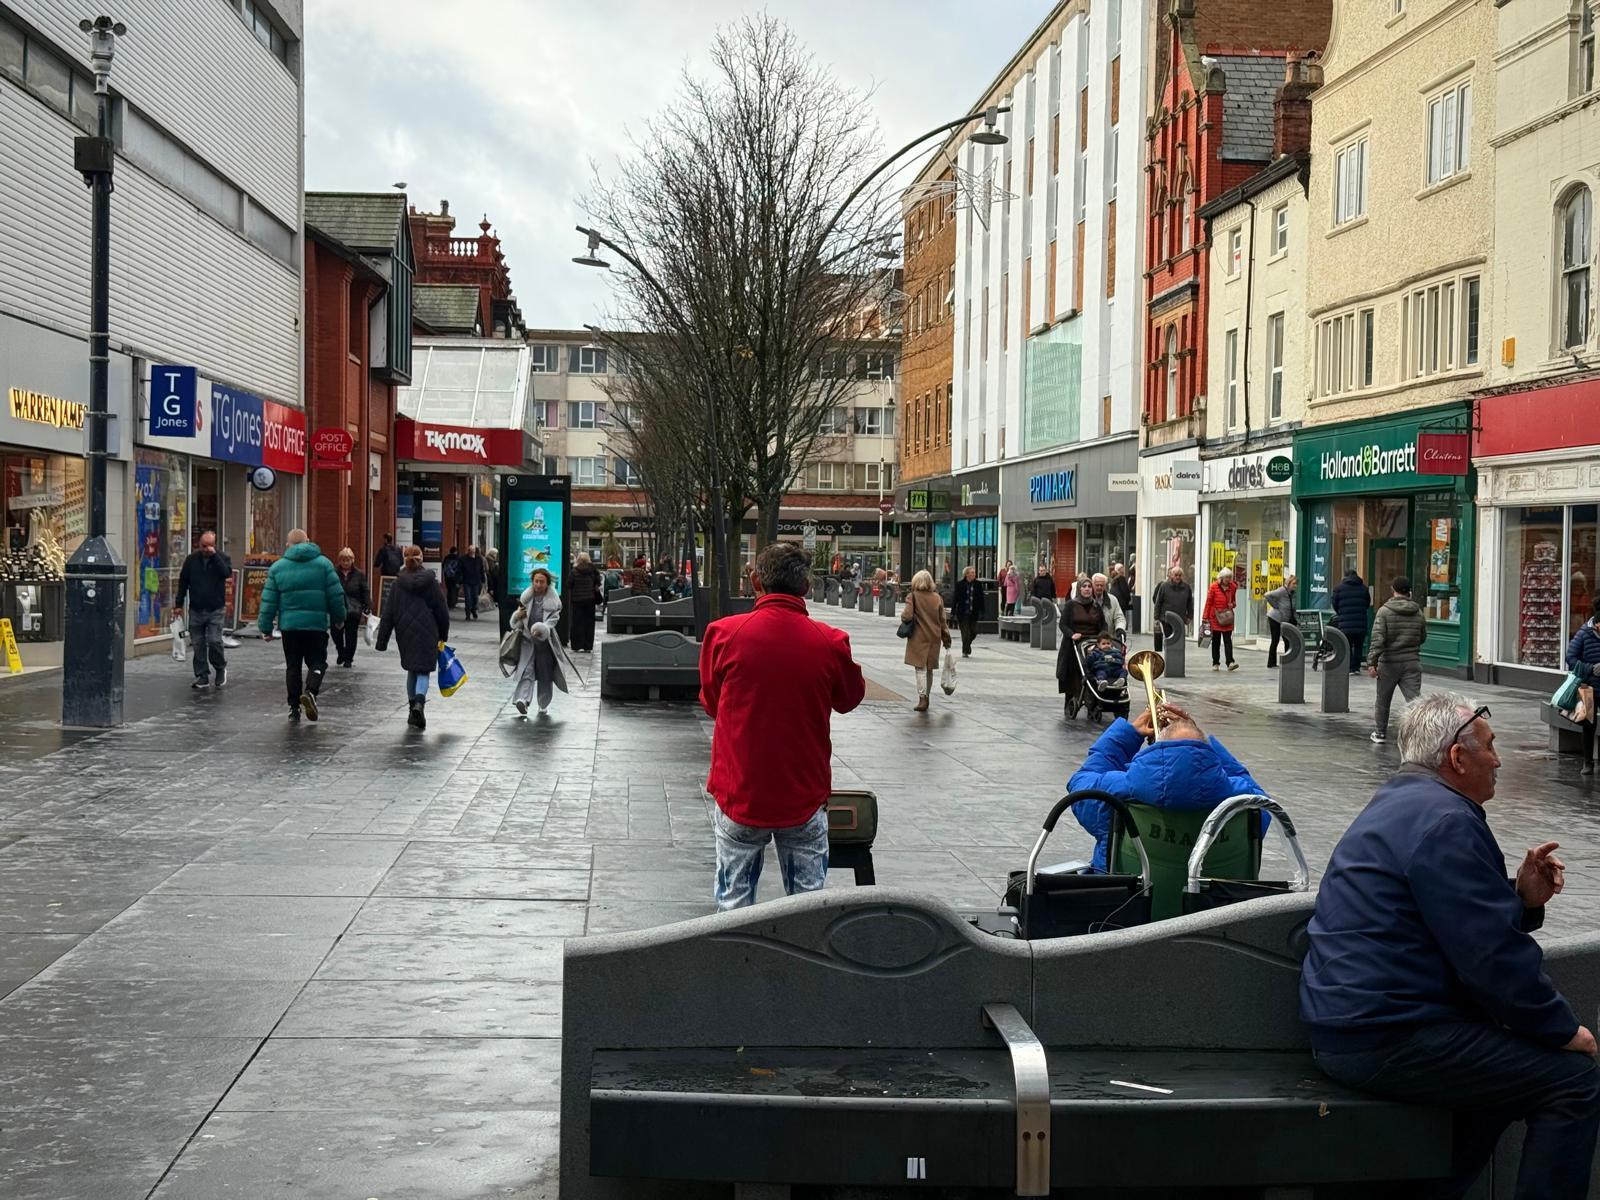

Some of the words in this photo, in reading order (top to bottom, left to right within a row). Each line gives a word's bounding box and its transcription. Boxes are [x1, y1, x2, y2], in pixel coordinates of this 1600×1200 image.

[10, 386, 57, 425] WARREN
[155, 416, 188, 429] Jones
[264, 420, 282, 450] POST
[283, 425, 305, 456] OFFICE
[320, 433, 345, 443] POST
[314, 442, 348, 453] OFFICE
[1423, 448, 1462, 461] Clintons
[1176, 471, 1200, 480] claire's
[1228, 456, 1265, 490] claire's
[1030, 470, 1074, 503] PRIMARK
